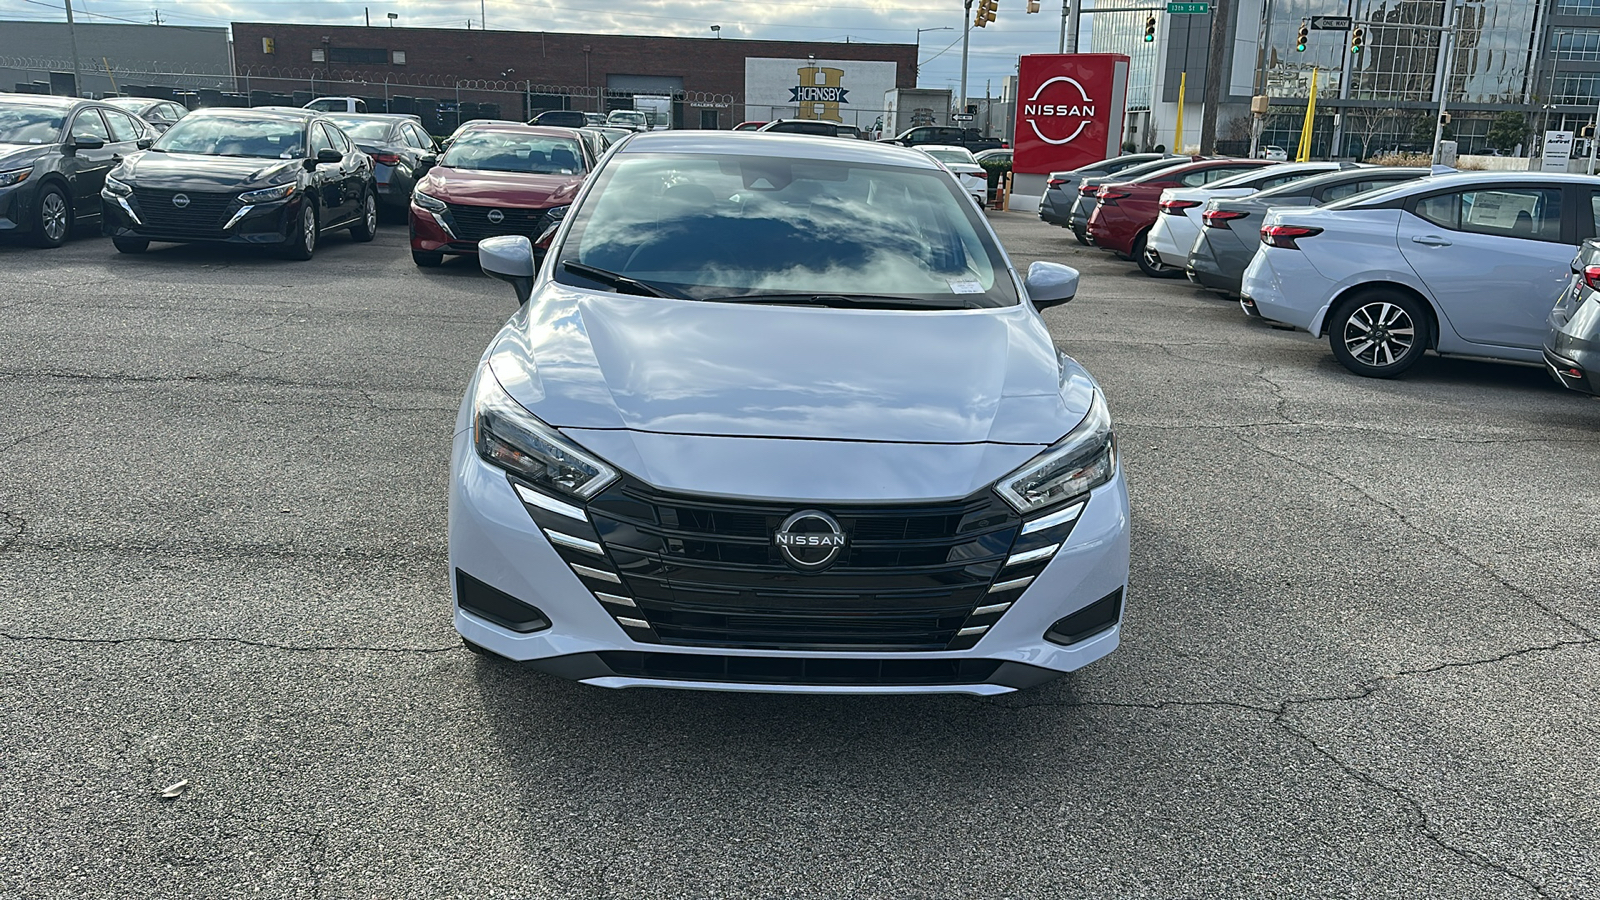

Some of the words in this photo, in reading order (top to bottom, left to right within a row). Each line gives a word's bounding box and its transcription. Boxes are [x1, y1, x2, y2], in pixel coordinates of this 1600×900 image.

[1171, 4, 1184, 12] 13th
[1188, 4, 1196, 12] St
[797, 87, 842, 101] HORNSBY
[1024, 104, 1095, 117] NISSAN
[776, 534, 845, 546] NISSAN
